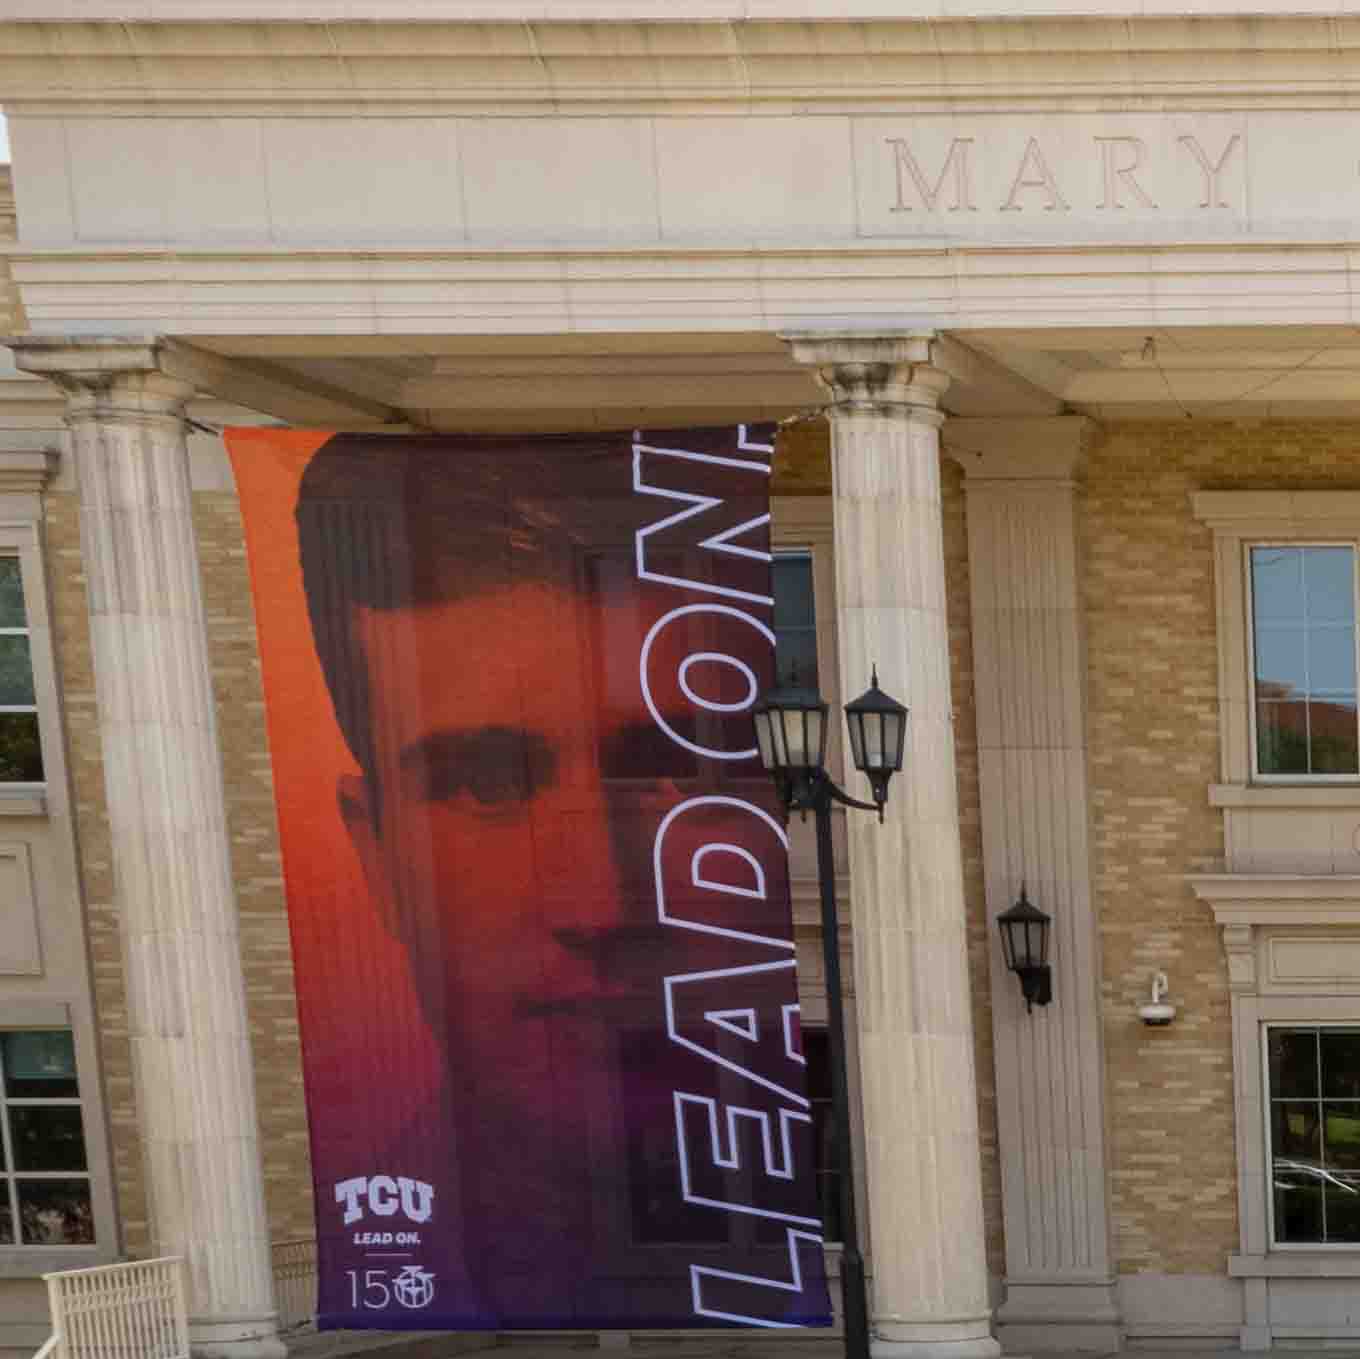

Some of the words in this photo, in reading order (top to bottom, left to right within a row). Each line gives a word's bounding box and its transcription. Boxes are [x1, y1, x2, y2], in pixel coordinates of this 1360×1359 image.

[885, 135, 1241, 214] MARY
[654, 796, 823, 1329] LEAD
[335, 1175, 434, 1224] TCU
[353, 1232, 393, 1245] LEAD
[395, 1232, 422, 1245] ON.
